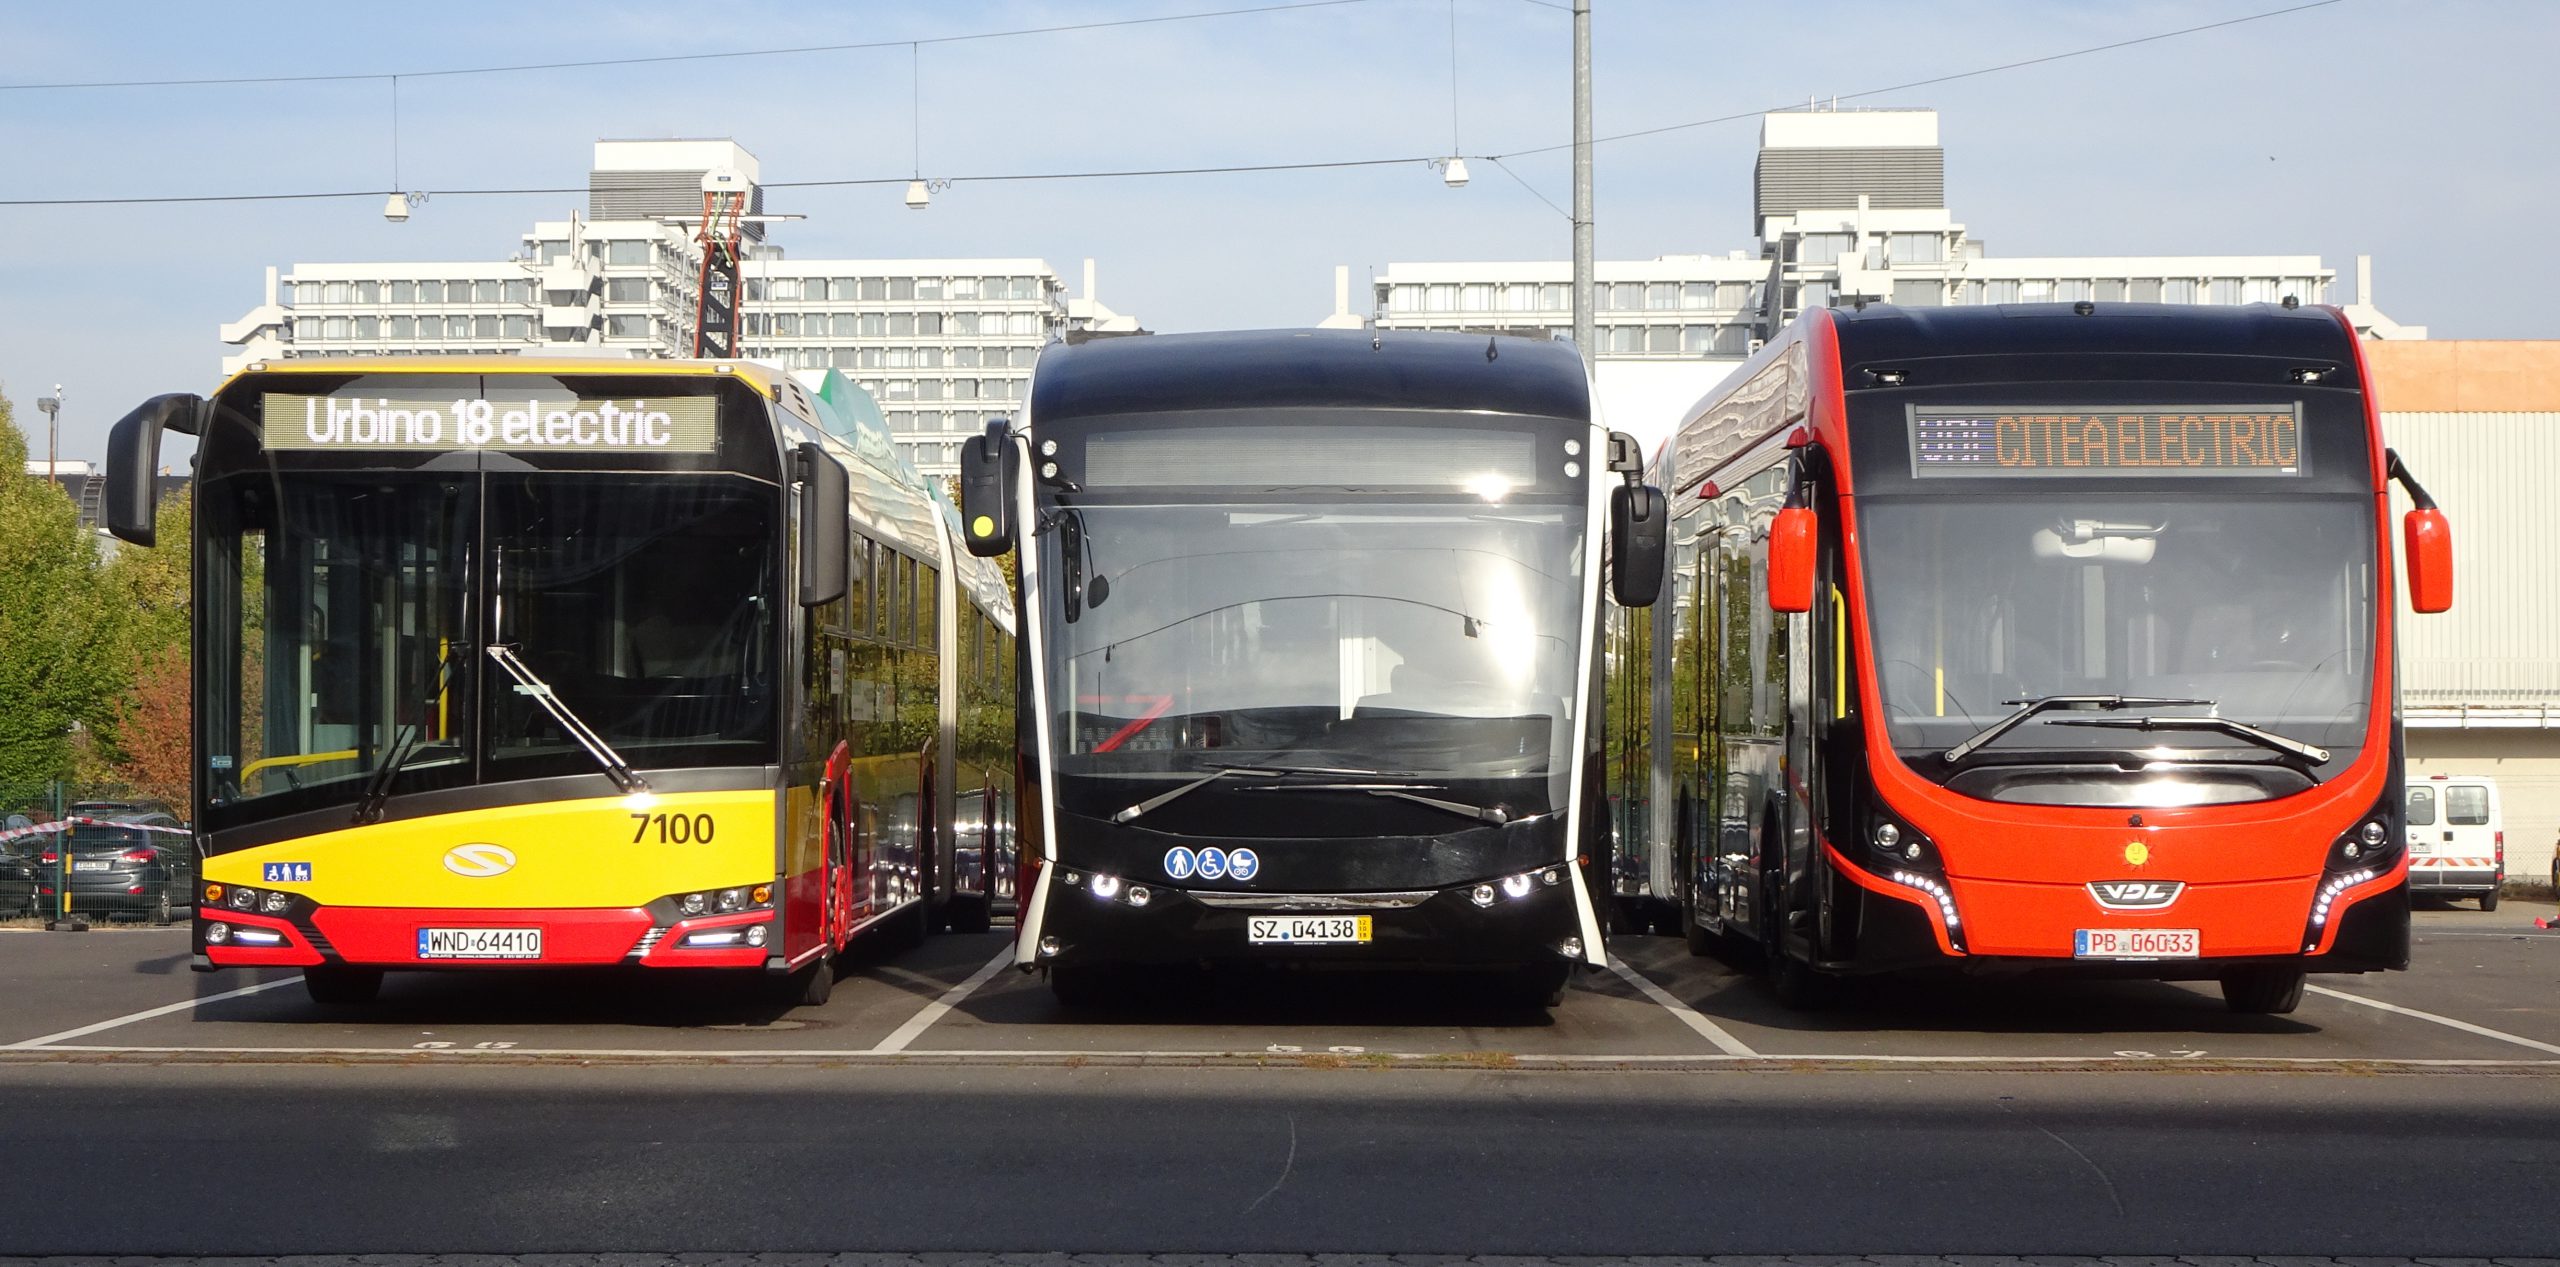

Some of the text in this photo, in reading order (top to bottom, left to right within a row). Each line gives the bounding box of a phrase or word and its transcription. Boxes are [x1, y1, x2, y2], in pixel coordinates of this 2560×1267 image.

[306, 397, 671, 445] Urbino 18 electric
[1995, 415, 2109, 467] CITEA
[2117, 415, 2297, 467] ELECTRIC
[630, 813, 715, 844] 7100
[2102, 883, 2167, 900] VDL
[1253, 920, 1354, 938] SZ 04138
[431, 931, 538, 951] WND 64410
[2092, 933, 2193, 952] PB 06033
